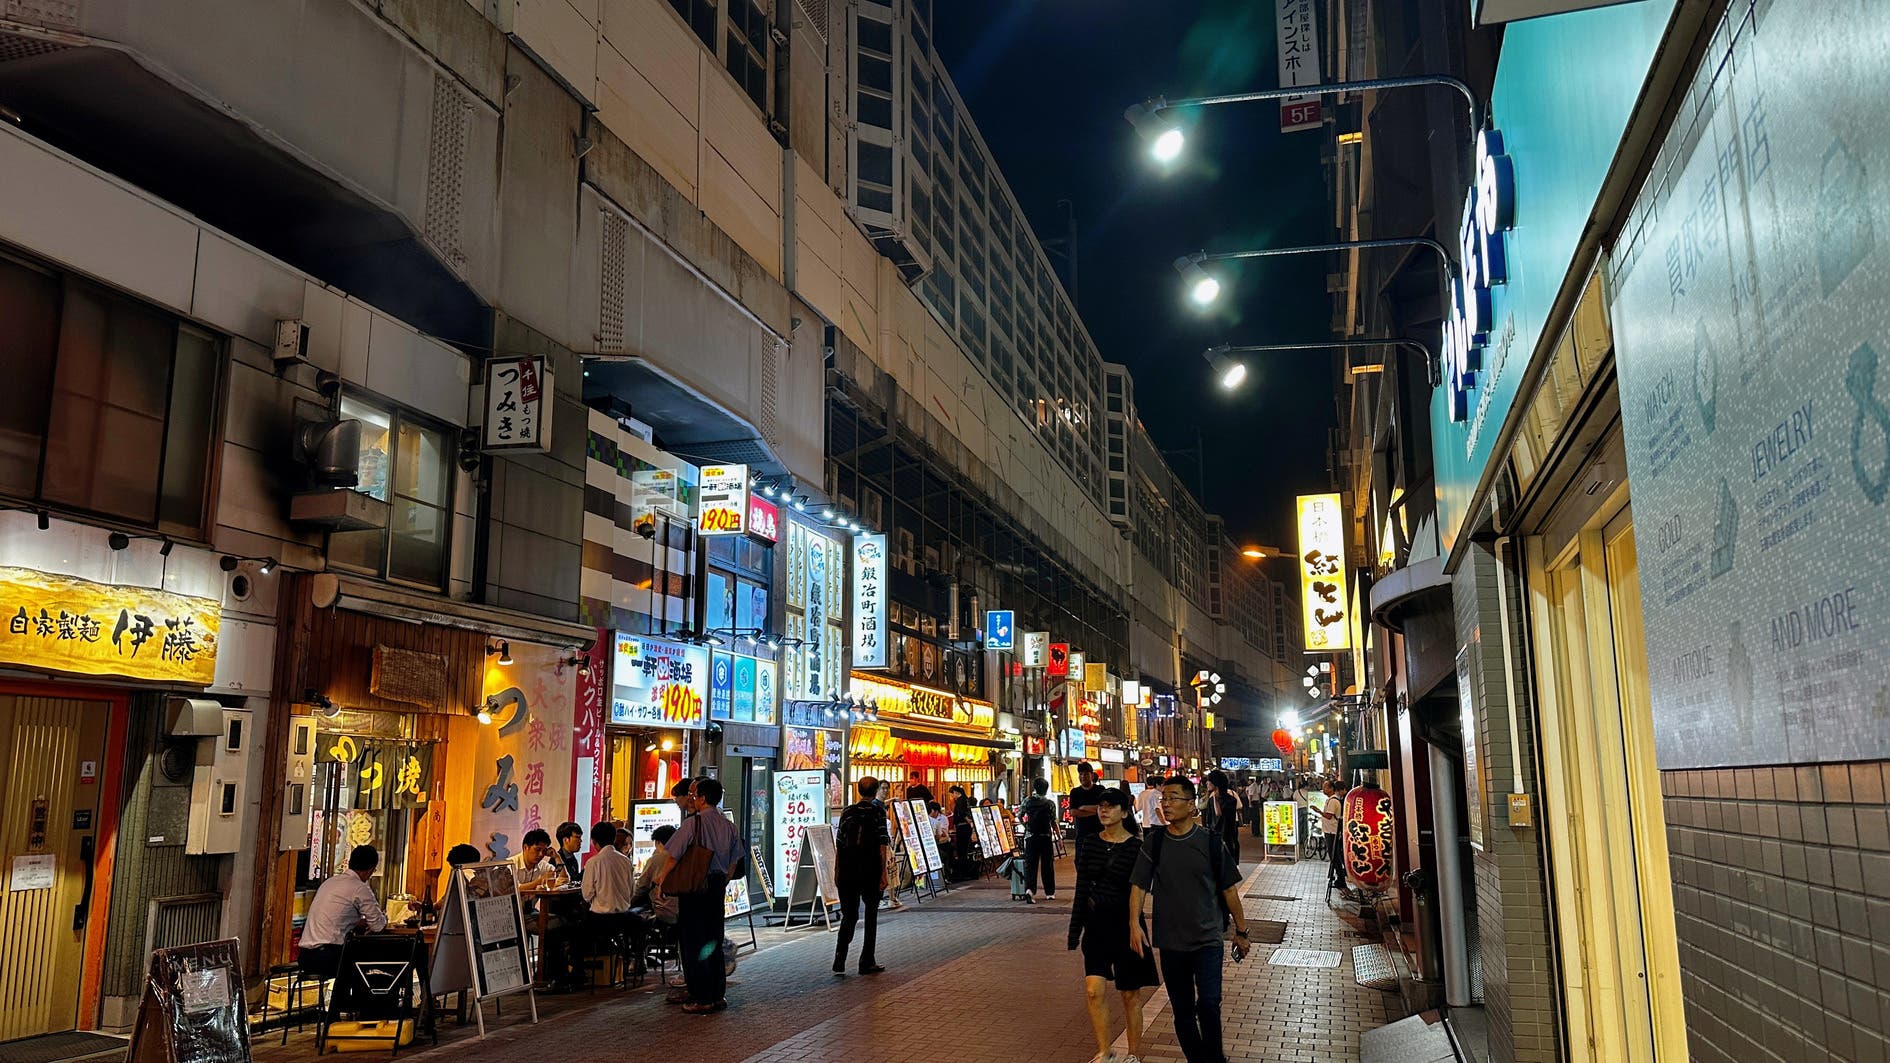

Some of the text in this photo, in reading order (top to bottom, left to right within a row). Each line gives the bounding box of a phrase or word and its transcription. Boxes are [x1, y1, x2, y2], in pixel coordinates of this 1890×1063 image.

[1299, 0, 1311, 52] 部屋探しは
[1291, 106, 1315, 123] 5F
[1665, 90, 1771, 314] 買取専門店
[496, 368, 519, 440] つみき
[519, 369, 537, 438] 千住 もつ焼
[1644, 367, 1675, 424] WATCH
[1751, 399, 1814, 484] JEWELRY
[700, 508, 741, 531] 190円
[1658, 515, 1682, 553] GOLD
[9, 606, 201, 665] 自家製麺 伊藤
[861, 566, 878, 648] 鍛冶町酒場
[1771, 587, 1860, 653] AND MORE
[630, 654, 693, 684] 一軒め酒場
[1673, 645, 1714, 685] ANTIQUE
[549, 656, 567, 752] もつ焼
[663, 682, 703, 723] 190円
[521, 677, 550, 831] 大衆酒場
